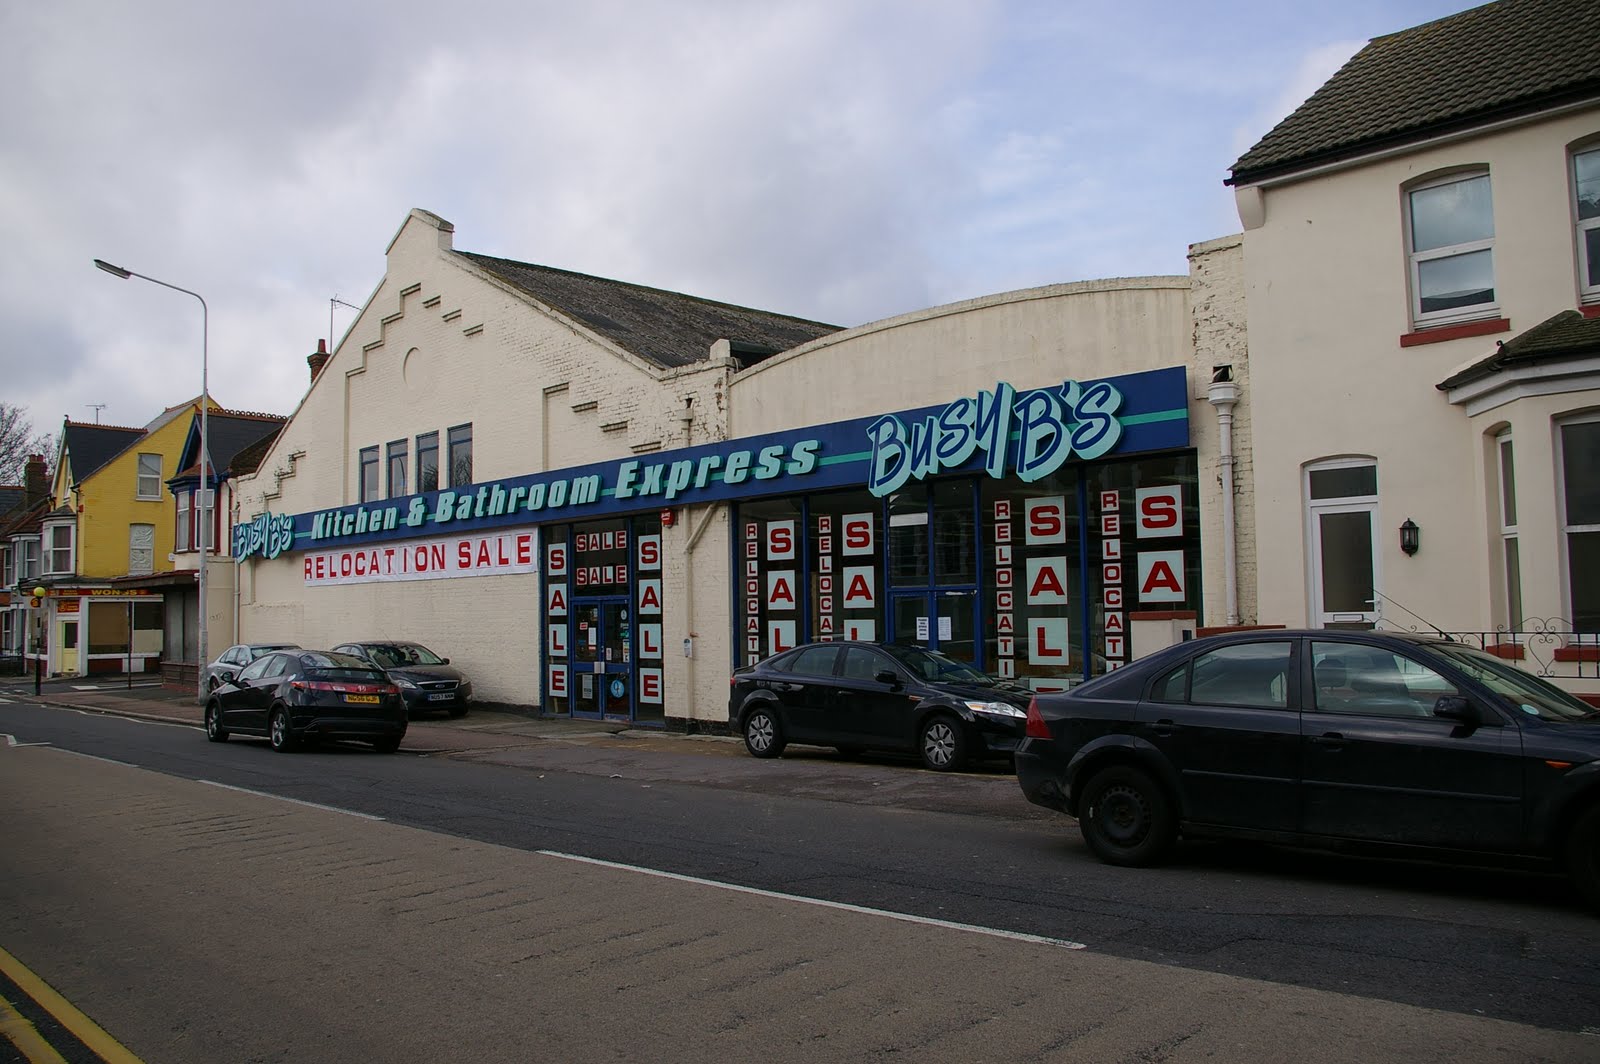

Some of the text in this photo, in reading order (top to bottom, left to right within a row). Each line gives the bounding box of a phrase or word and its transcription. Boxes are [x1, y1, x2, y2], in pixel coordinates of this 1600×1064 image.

[311, 439, 821, 540] Kitchen & Bathroom Express
[303, 535, 532, 580] RELOCATION SALE
[576, 532, 626, 552] SALE
[576, 566, 626, 585] SALE
[550, 549, 566, 691] SALE
[641, 541, 660, 698] SALE
[1029, 505, 1065, 692] SAL
